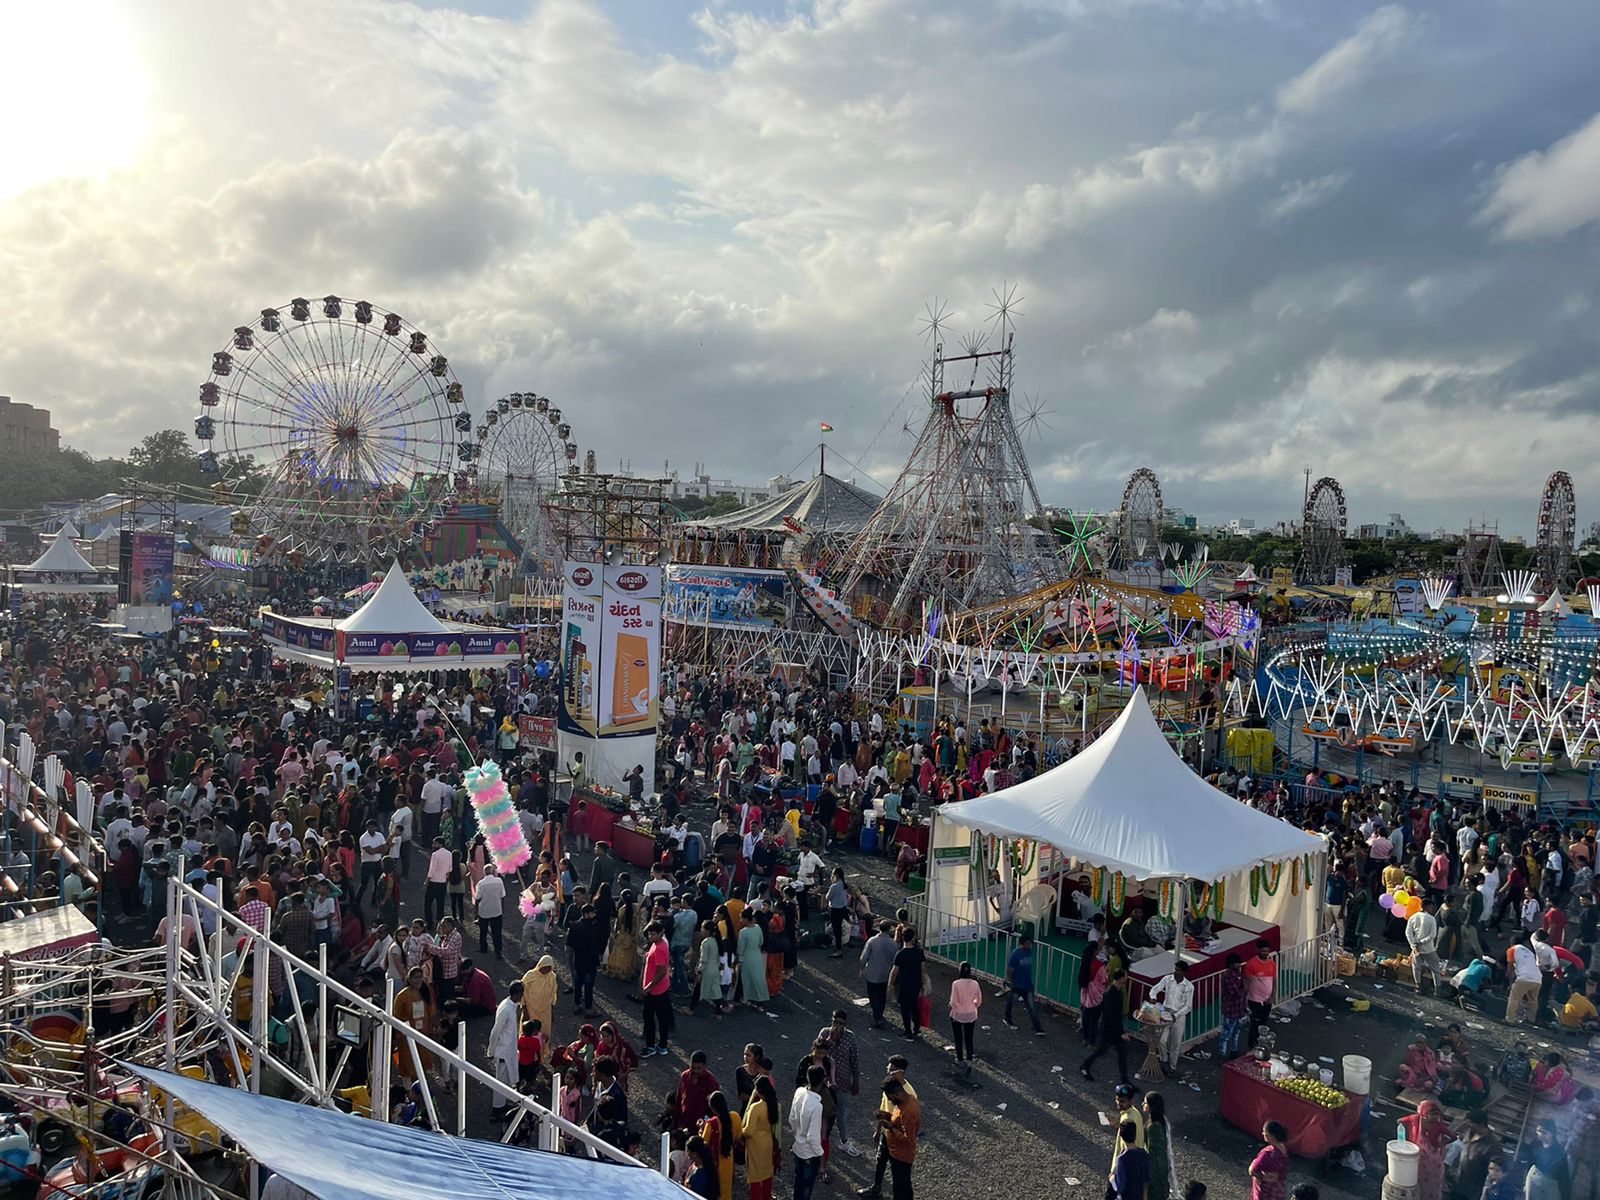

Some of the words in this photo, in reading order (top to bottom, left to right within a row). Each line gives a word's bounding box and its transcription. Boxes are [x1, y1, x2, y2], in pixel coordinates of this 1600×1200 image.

[609, 600, 641, 617] ચંદન
[349, 637, 377, 647] Amul
[468, 637, 492, 647] Amul
[1451, 776, 1474, 785] IN
[1485, 789, 1531, 801] BOOKING
